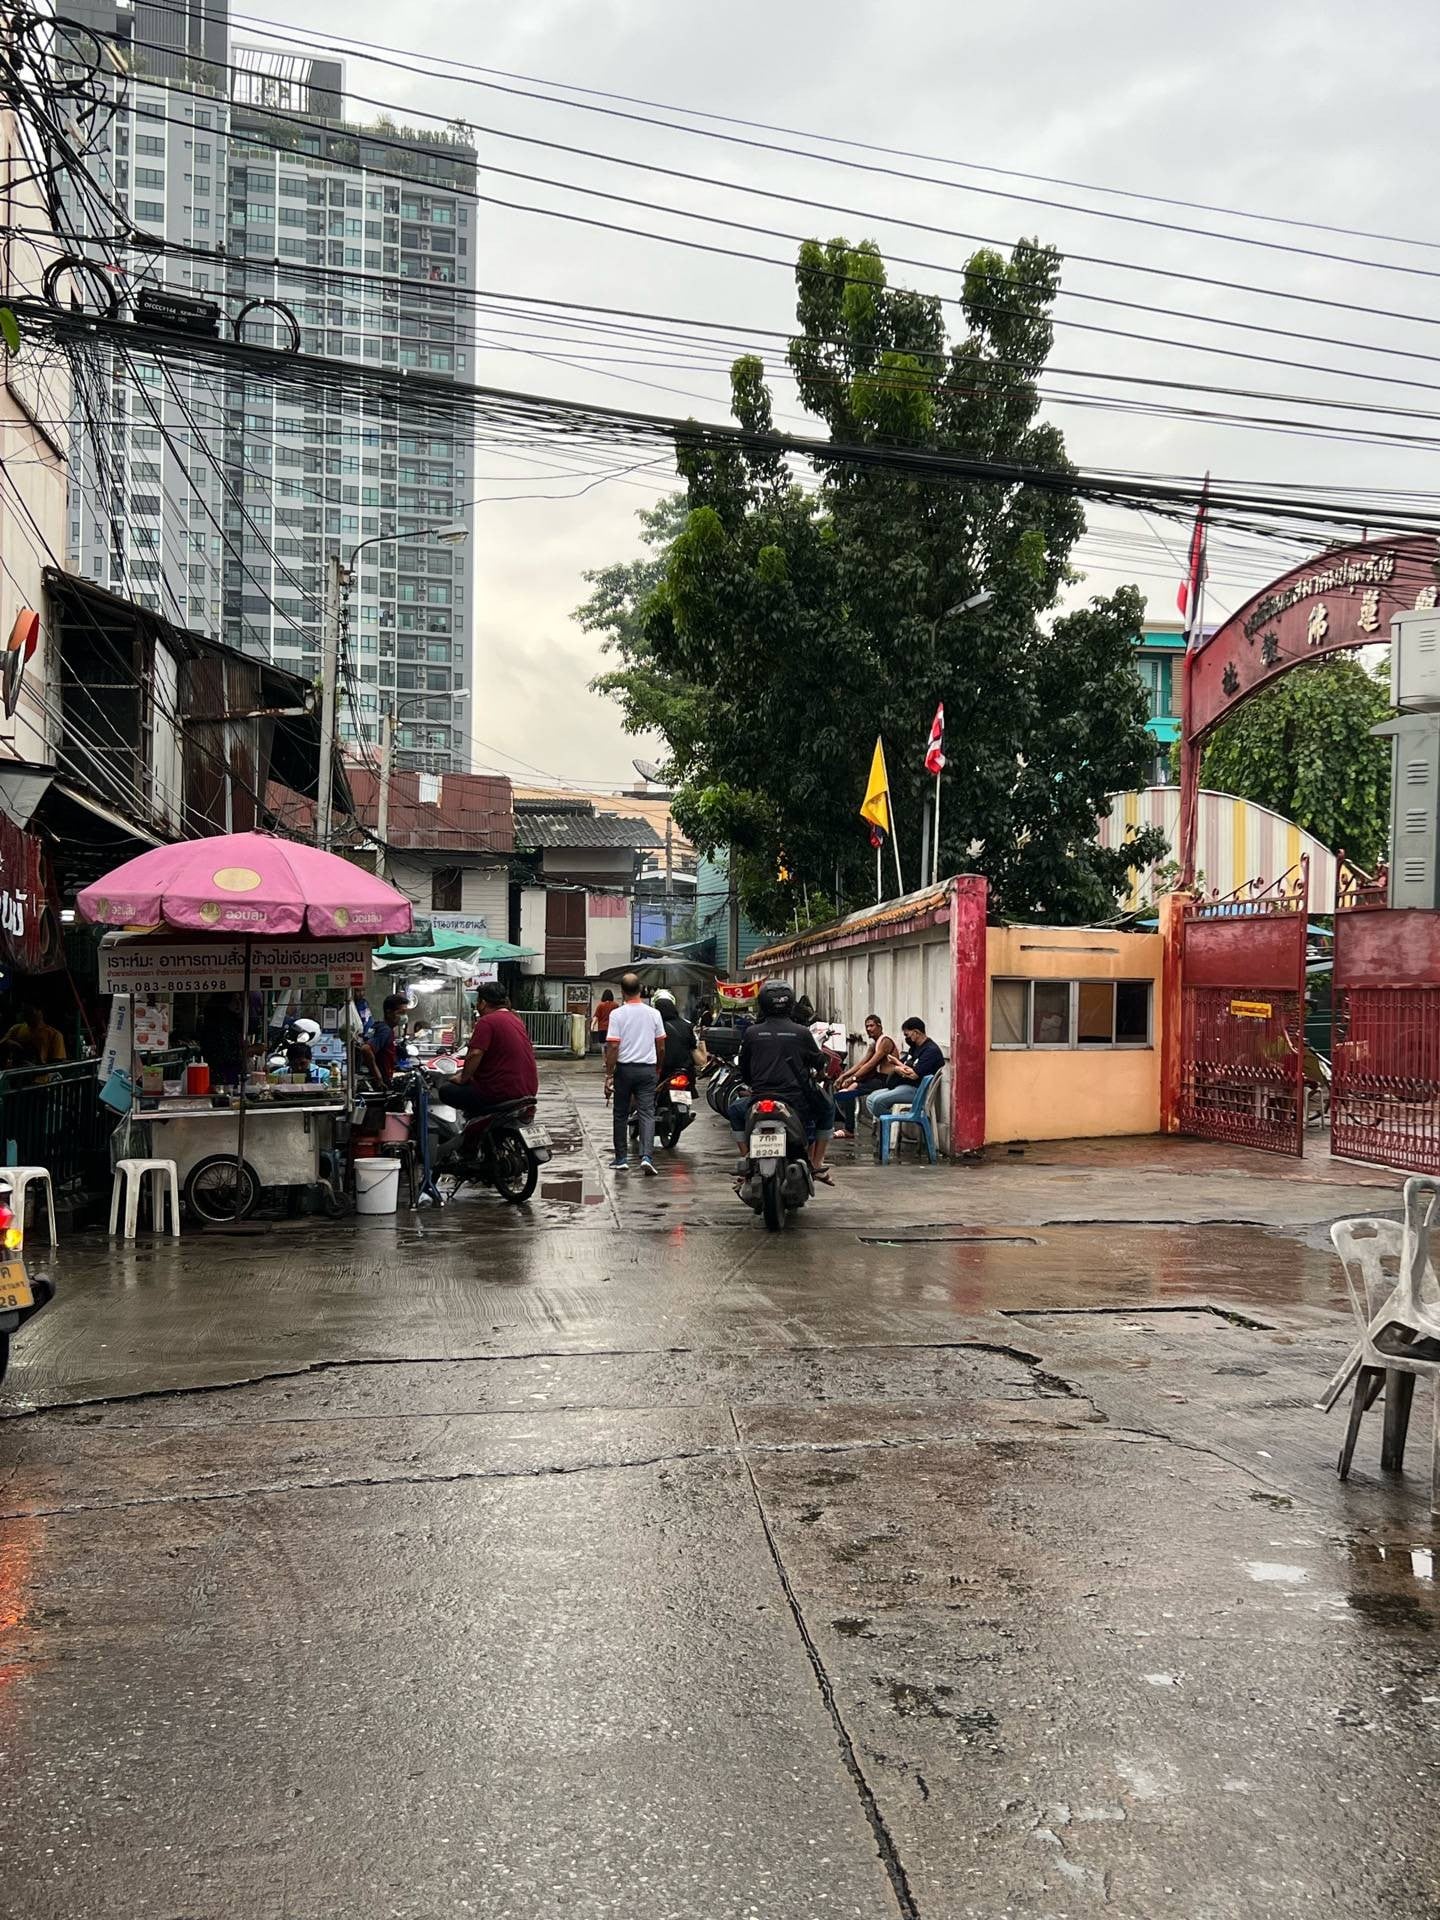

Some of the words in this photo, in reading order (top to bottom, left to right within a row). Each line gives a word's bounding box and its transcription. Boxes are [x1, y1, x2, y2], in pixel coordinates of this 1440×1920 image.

[252, 948, 364, 968] ข้าวไข่เจียวลุยสวน
